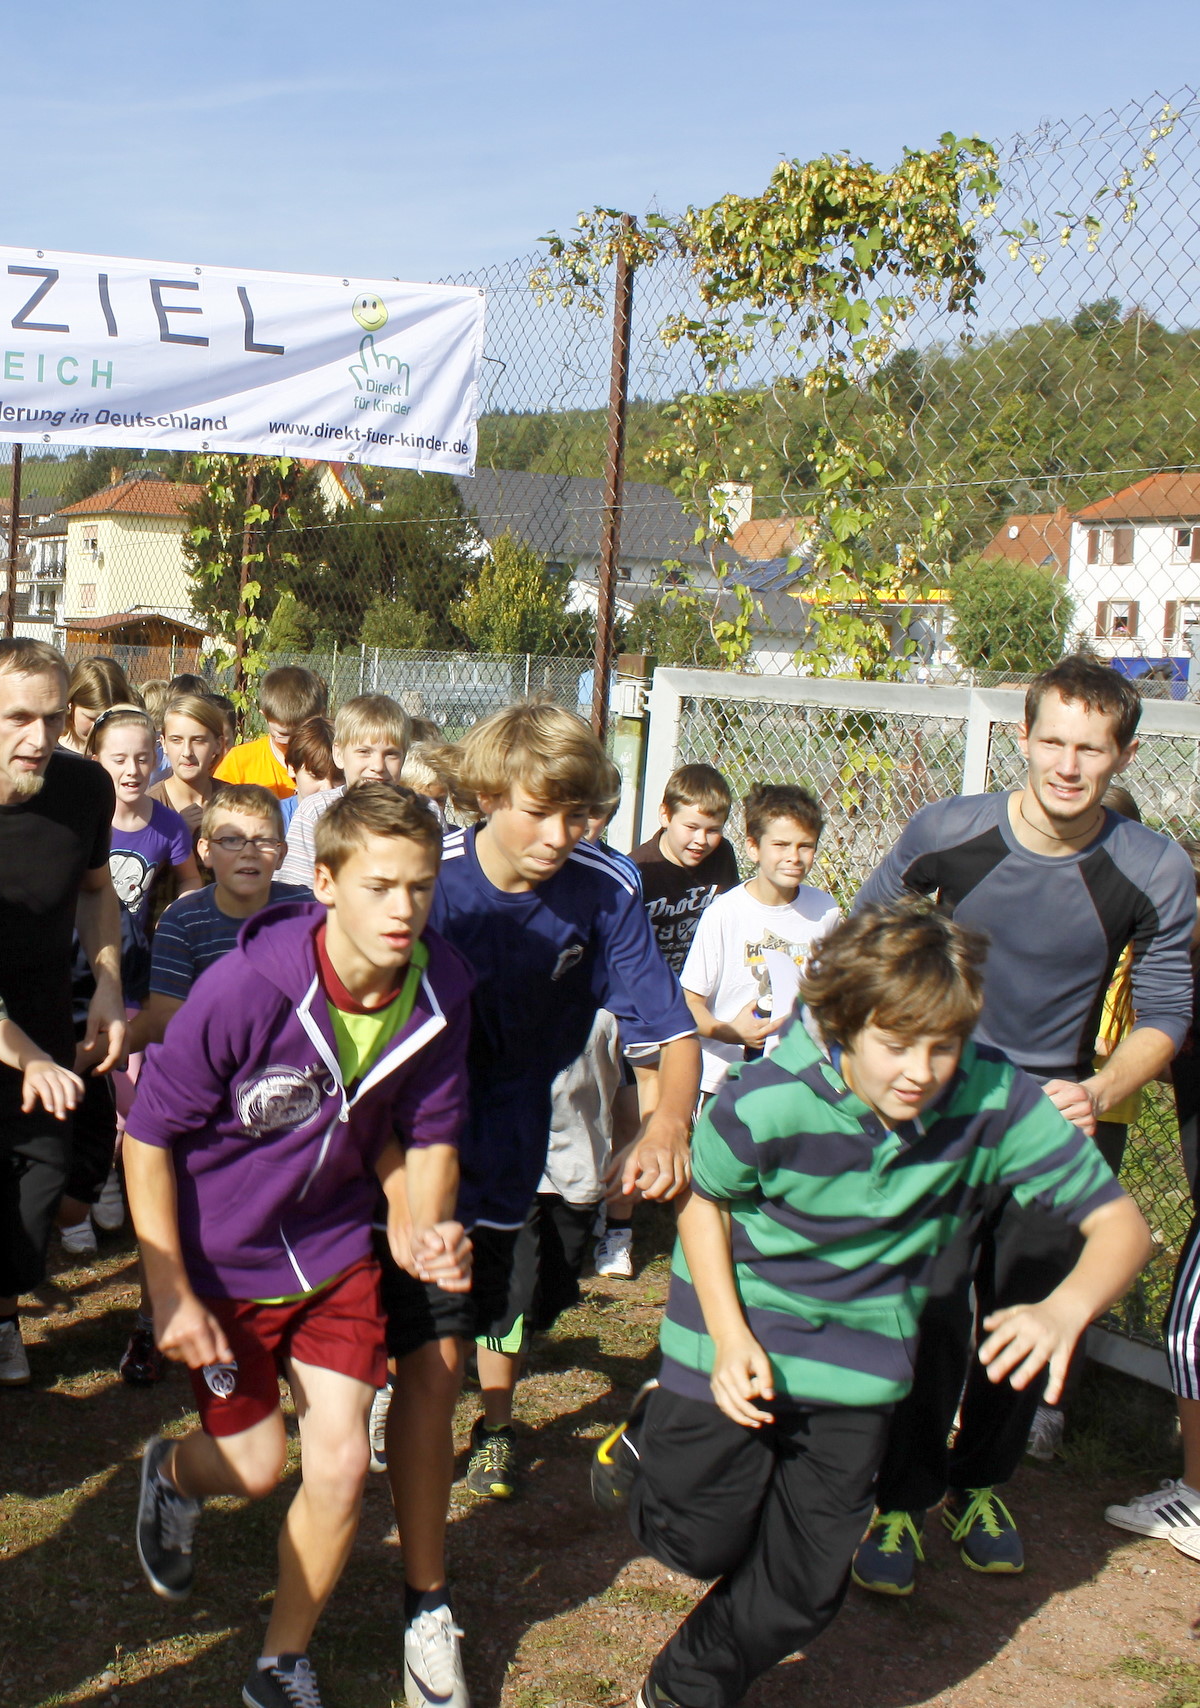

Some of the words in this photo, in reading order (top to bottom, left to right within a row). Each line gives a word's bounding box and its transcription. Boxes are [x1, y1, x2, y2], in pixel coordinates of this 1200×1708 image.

[7, 264, 285, 356] ZIEL
[366, 379, 402, 396] Direkt
[354, 396, 370, 411] für
[373, 398, 411, 416] Kinder
[69, 408, 90, 424] in
[95, 409, 229, 432] Deutschland
[269, 421, 469, 454] www.direkt-fuer-kinder.de
